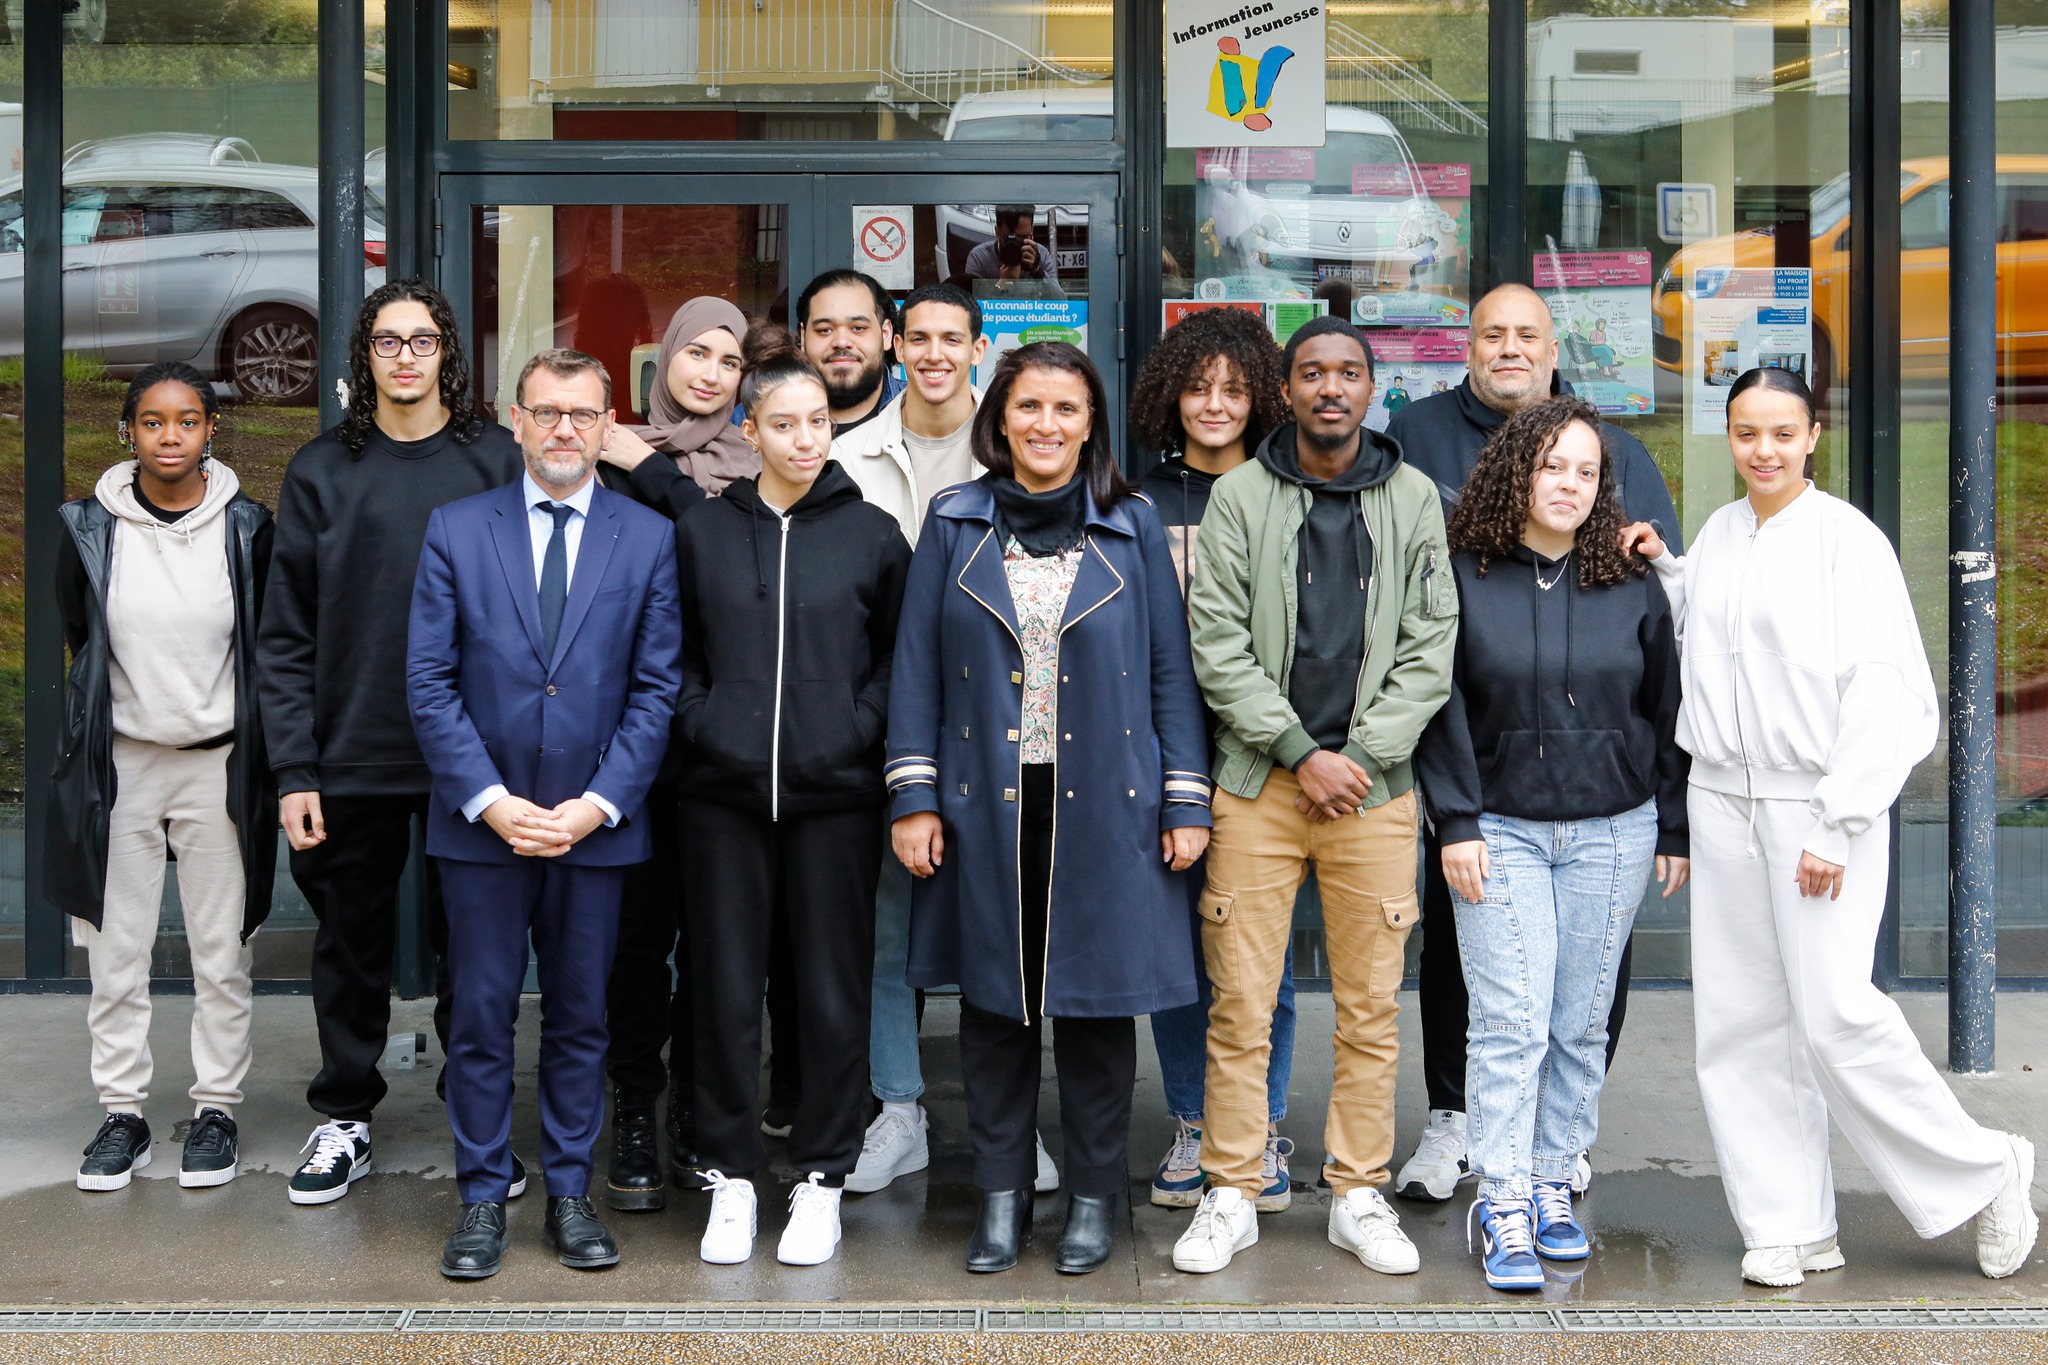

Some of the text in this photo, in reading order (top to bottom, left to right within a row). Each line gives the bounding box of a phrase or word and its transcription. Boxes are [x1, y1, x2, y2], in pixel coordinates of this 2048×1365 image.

[1172, 2, 1274, 44] Information
[1244, 6, 1319, 39] Jeunesse
[982, 301, 1069, 313] Tu connais le coup
[982, 313, 1078, 324] de pouce étudiants ?
